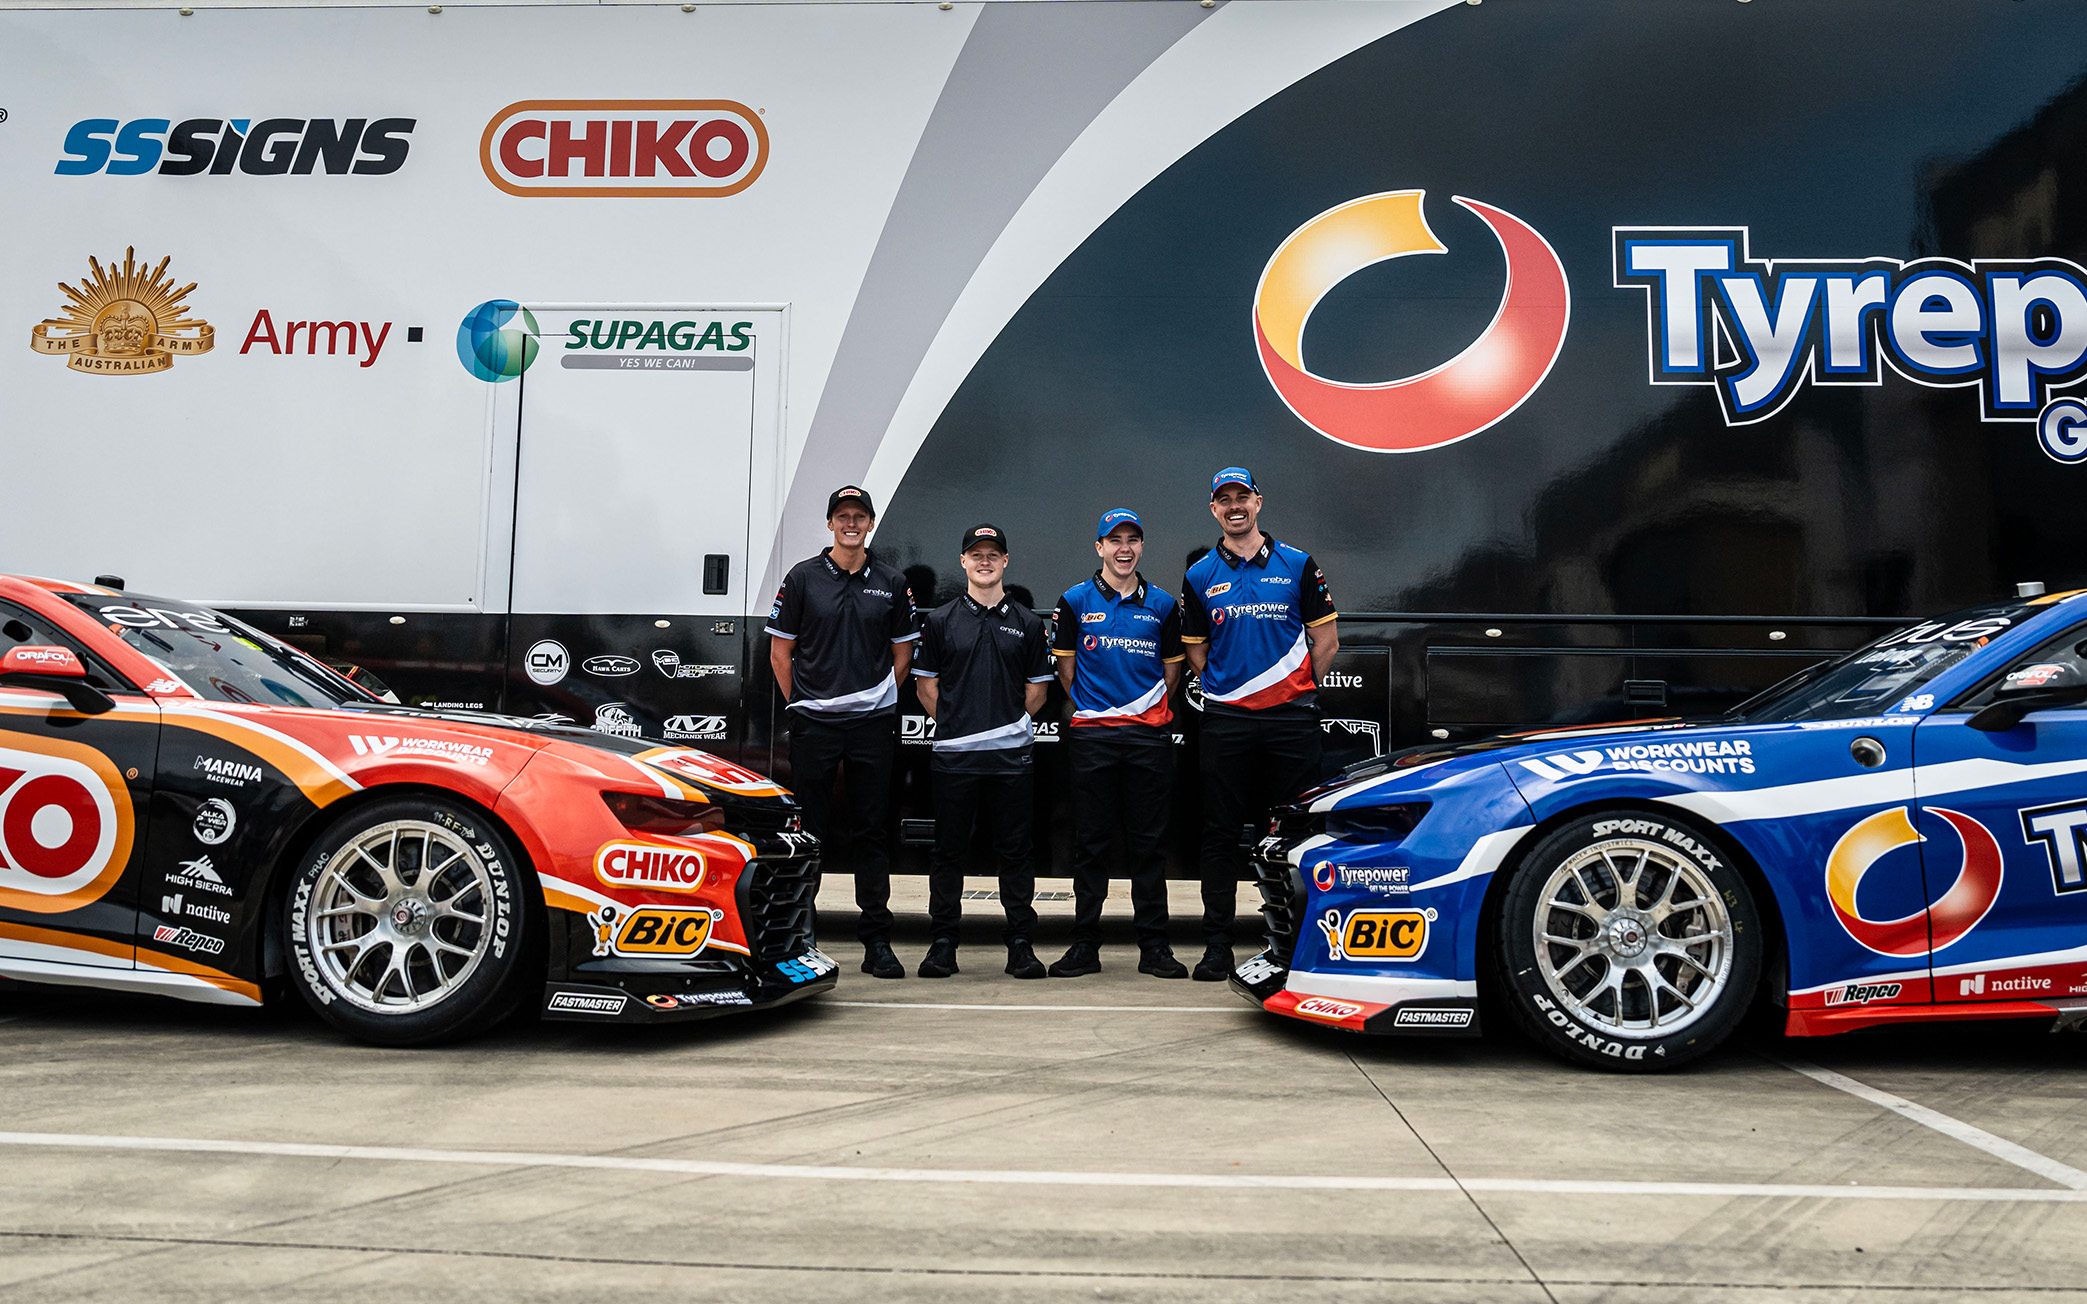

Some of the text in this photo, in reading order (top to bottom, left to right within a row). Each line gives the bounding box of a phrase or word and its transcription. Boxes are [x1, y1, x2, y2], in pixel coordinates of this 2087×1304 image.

[500, 118, 749, 178] CHIKO
[45, 339, 81, 351] THE
[156, 338, 206, 351] ARMY
[238, 307, 392, 368] Army
[564, 319, 754, 351] SUPAGAS
[74, 355, 168, 371] AUSTRALIAN
[619, 358, 696, 369] YES WE CAN!
[1225, 602, 1290, 618] Tyrepower
[1099, 635, 1157, 649] Tyrepower
[663, 731, 726, 740] MECHANIX WEAR
[396, 746, 489, 766] DISCOUNTS
[402, 737, 494, 757] WORKWEAR
[1605, 739, 1752, 760] WORKWEAR
[193, 755, 262, 782] MARINA
[1612, 755, 1756, 774] DISCOUNTS
[206, 773, 245, 788] RACEWEAR
[196, 814, 227, 827] PWER
[201, 809, 225, 820] ALKA
[1592, 818, 1725, 872] SPORT MAXX
[308, 852, 330, 879] PRAC
[602, 849, 701, 884] CHIKO
[165, 872, 233, 897] HIGH SIERRA
[1337, 865, 1409, 887] Tyrepower
[1369, 884, 1379, 893] GET
[1379, 884, 1388, 892] THE
[475, 841, 512, 960] DUNLOP
[185, 902, 231, 924] natiive
[171, 927, 224, 954] Repco
[291, 877, 338, 1006] SPORT MAXX
[1843, 982, 1902, 1004] Repco
[1991, 975, 2052, 992] natiive
[553, 996, 622, 1011] FASTMASTER
[674, 991, 745, 1005] Tyrepower
[1300, 999, 1358, 1016] CHIKO
[1399, 1012, 1469, 1023] FASTMASTER
[1533, 992, 1647, 1060] DUNLOP
